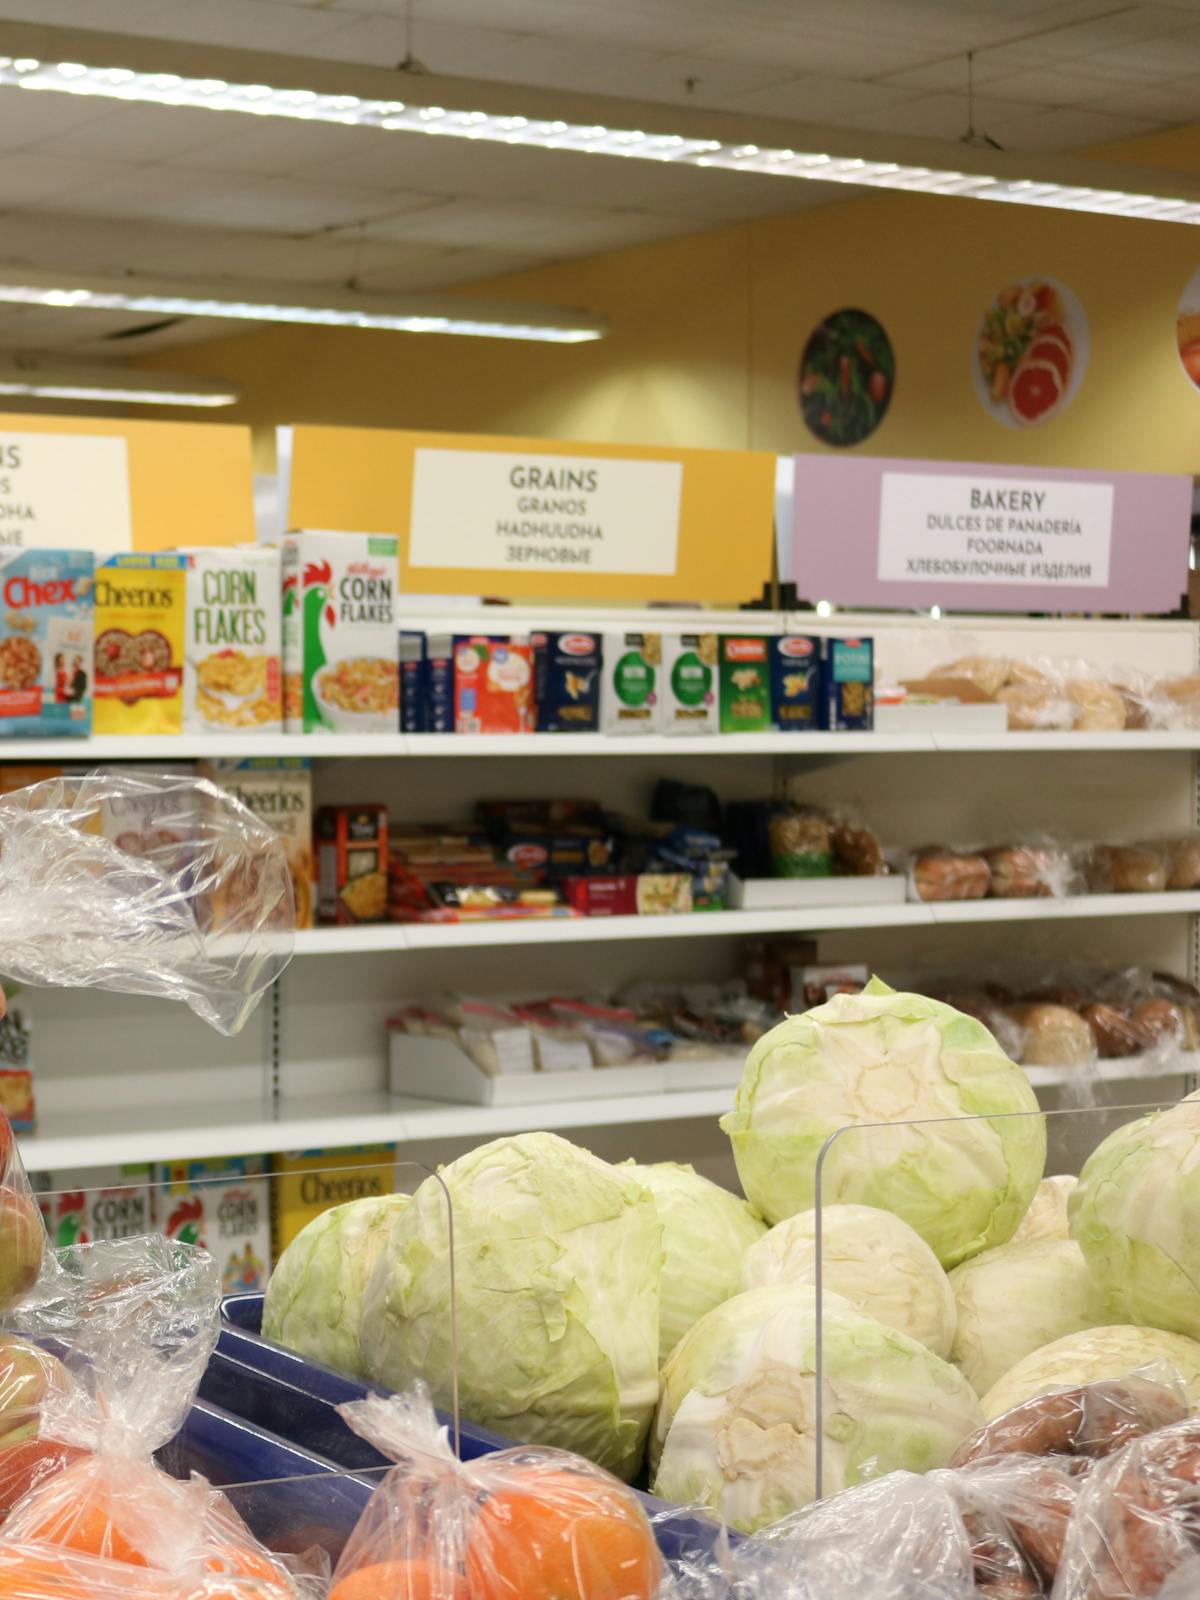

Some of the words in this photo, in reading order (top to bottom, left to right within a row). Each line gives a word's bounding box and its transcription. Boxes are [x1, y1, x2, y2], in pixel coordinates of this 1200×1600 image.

[509, 465, 599, 493] GRAINS
[517, 497, 587, 515] GRANOS
[970, 488, 1046, 512] BAKERY
[497, 521, 603, 540] HADHUUDHA
[927, 514, 981, 532] DULCES
[986, 517, 1005, 533] DE
[506, 546, 592, 565] ЗЕРНОВЫЕ
[967, 538, 1043, 555] FOORNADA
[3, 575, 77, 610] Chex
[94, 580, 173, 610] Cheerios
[203, 571, 256, 605] CORN
[340, 577, 392, 602] CORN
[195, 608, 266, 644] FLAKES
[341, 605, 393, 624] FLAKES
[301, 1172, 381, 1205] Cheerios
[93, 1197, 145, 1224] CORN
[217, 1199, 258, 1221] CORN
